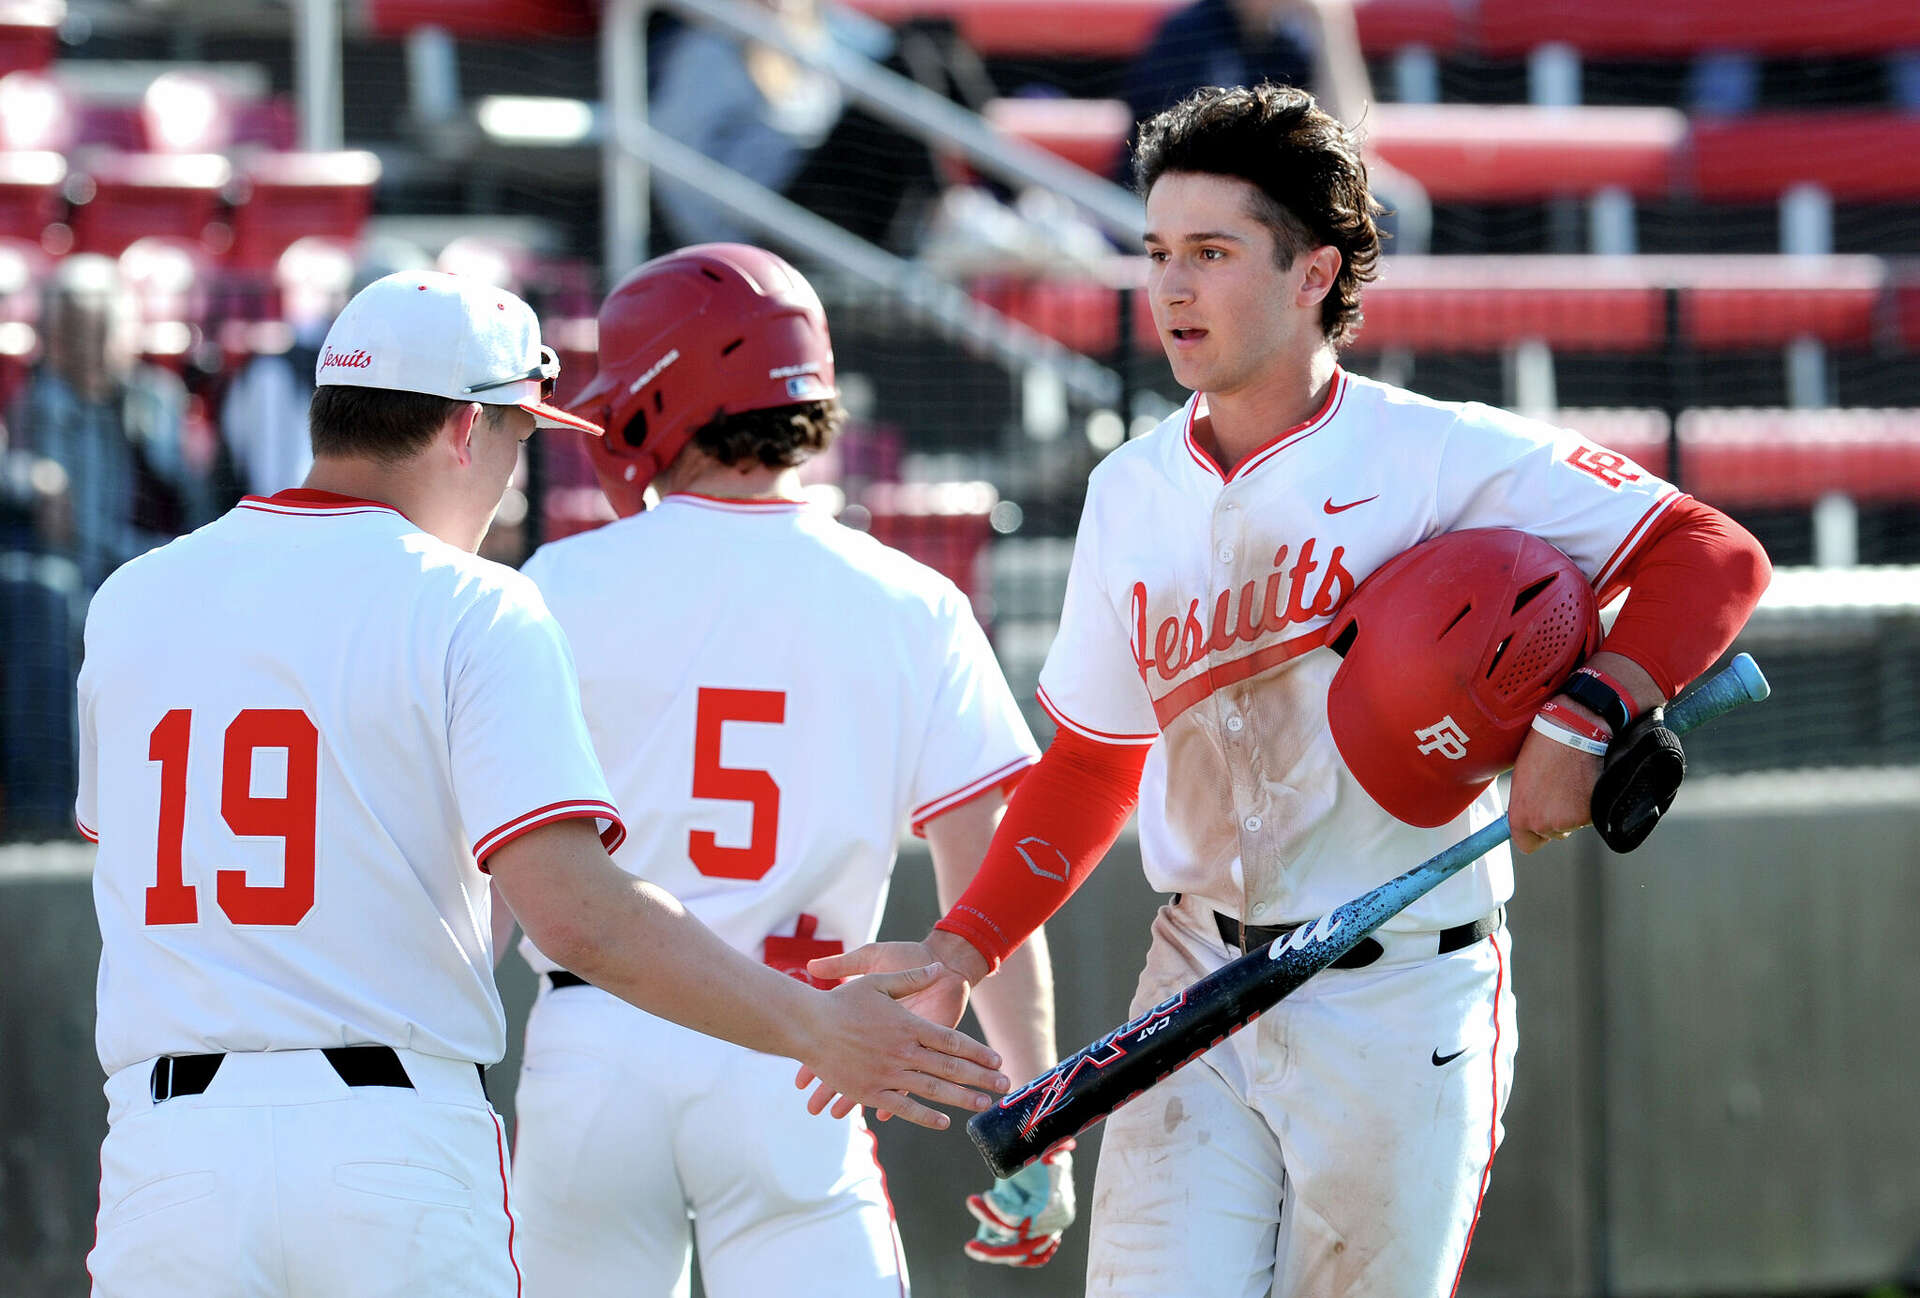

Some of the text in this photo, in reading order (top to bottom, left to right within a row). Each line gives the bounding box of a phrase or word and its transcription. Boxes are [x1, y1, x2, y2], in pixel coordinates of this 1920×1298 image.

[320, 346, 372, 373] Jesuits
[1131, 537, 1355, 684] Jesuits
[144, 708, 319, 926] 19
[688, 686, 787, 881] 5
[1136, 1015, 1171, 1043] CAT
